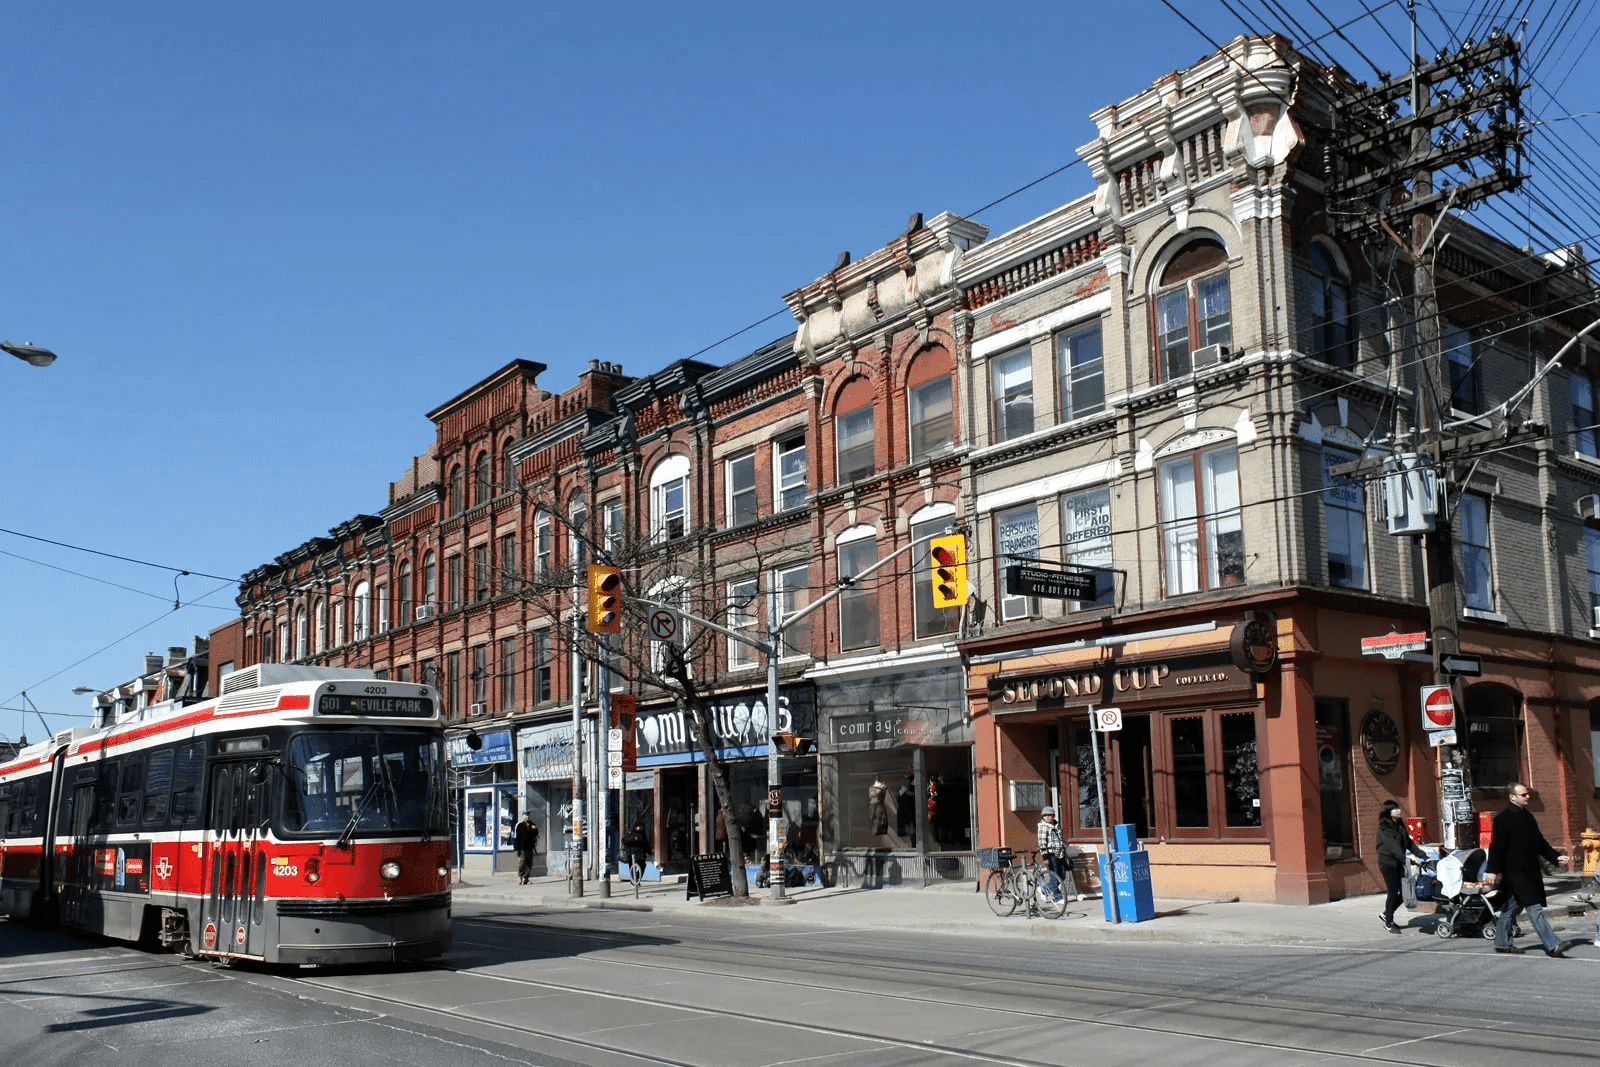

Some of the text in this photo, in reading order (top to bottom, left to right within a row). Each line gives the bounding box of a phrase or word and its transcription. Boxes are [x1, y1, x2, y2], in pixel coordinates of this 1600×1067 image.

[1074, 504, 1103, 520] FIRST
[1000, 519, 1037, 538] PERSONAL
[1091, 514, 1110, 527] AID
[1065, 525, 1110, 542] OFFERED
[1371, 644, 1395, 653] Queen
[364, 686, 387, 695] 4203
[1002, 663, 1230, 704] SECOND CUP COFFEE CO.
[321, 697, 340, 711] 501
[395, 699, 421, 713] PARK
[711, 692, 792, 744] woos
[840, 719, 902, 736] comrag
[272, 865, 298, 877] 4203
